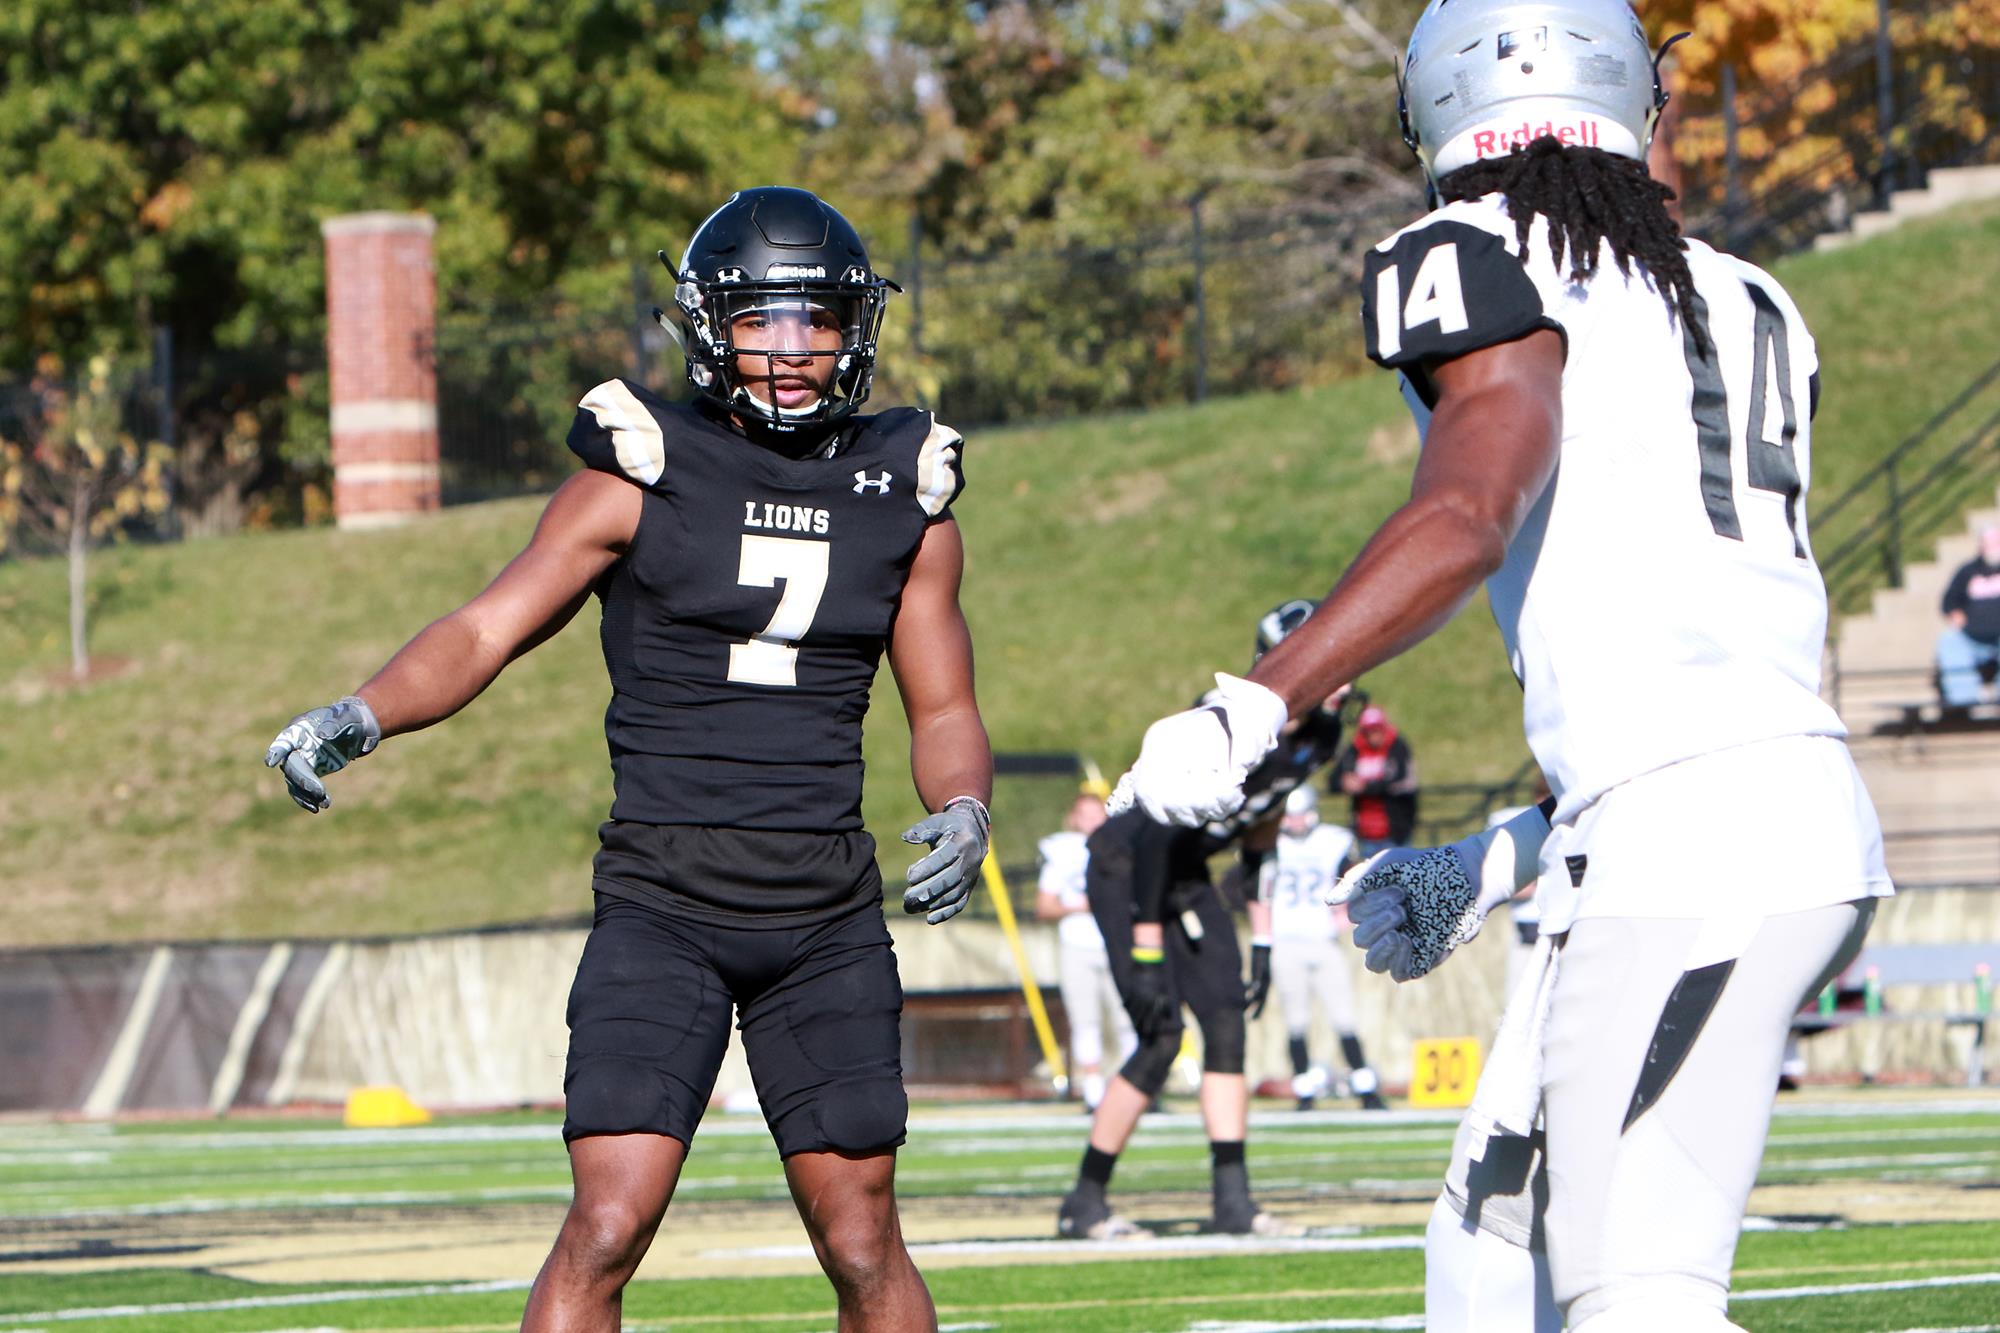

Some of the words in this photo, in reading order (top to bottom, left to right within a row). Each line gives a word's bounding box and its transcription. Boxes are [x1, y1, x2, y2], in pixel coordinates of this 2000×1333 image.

[1473, 121, 1598, 158] Riddell
[1377, 243, 1469, 360] 14
[1678, 280, 1807, 559] 14
[744, 501, 831, 534] LIONS
[727, 534, 831, 687] 7
[1424, 1047, 1466, 1094] 30
